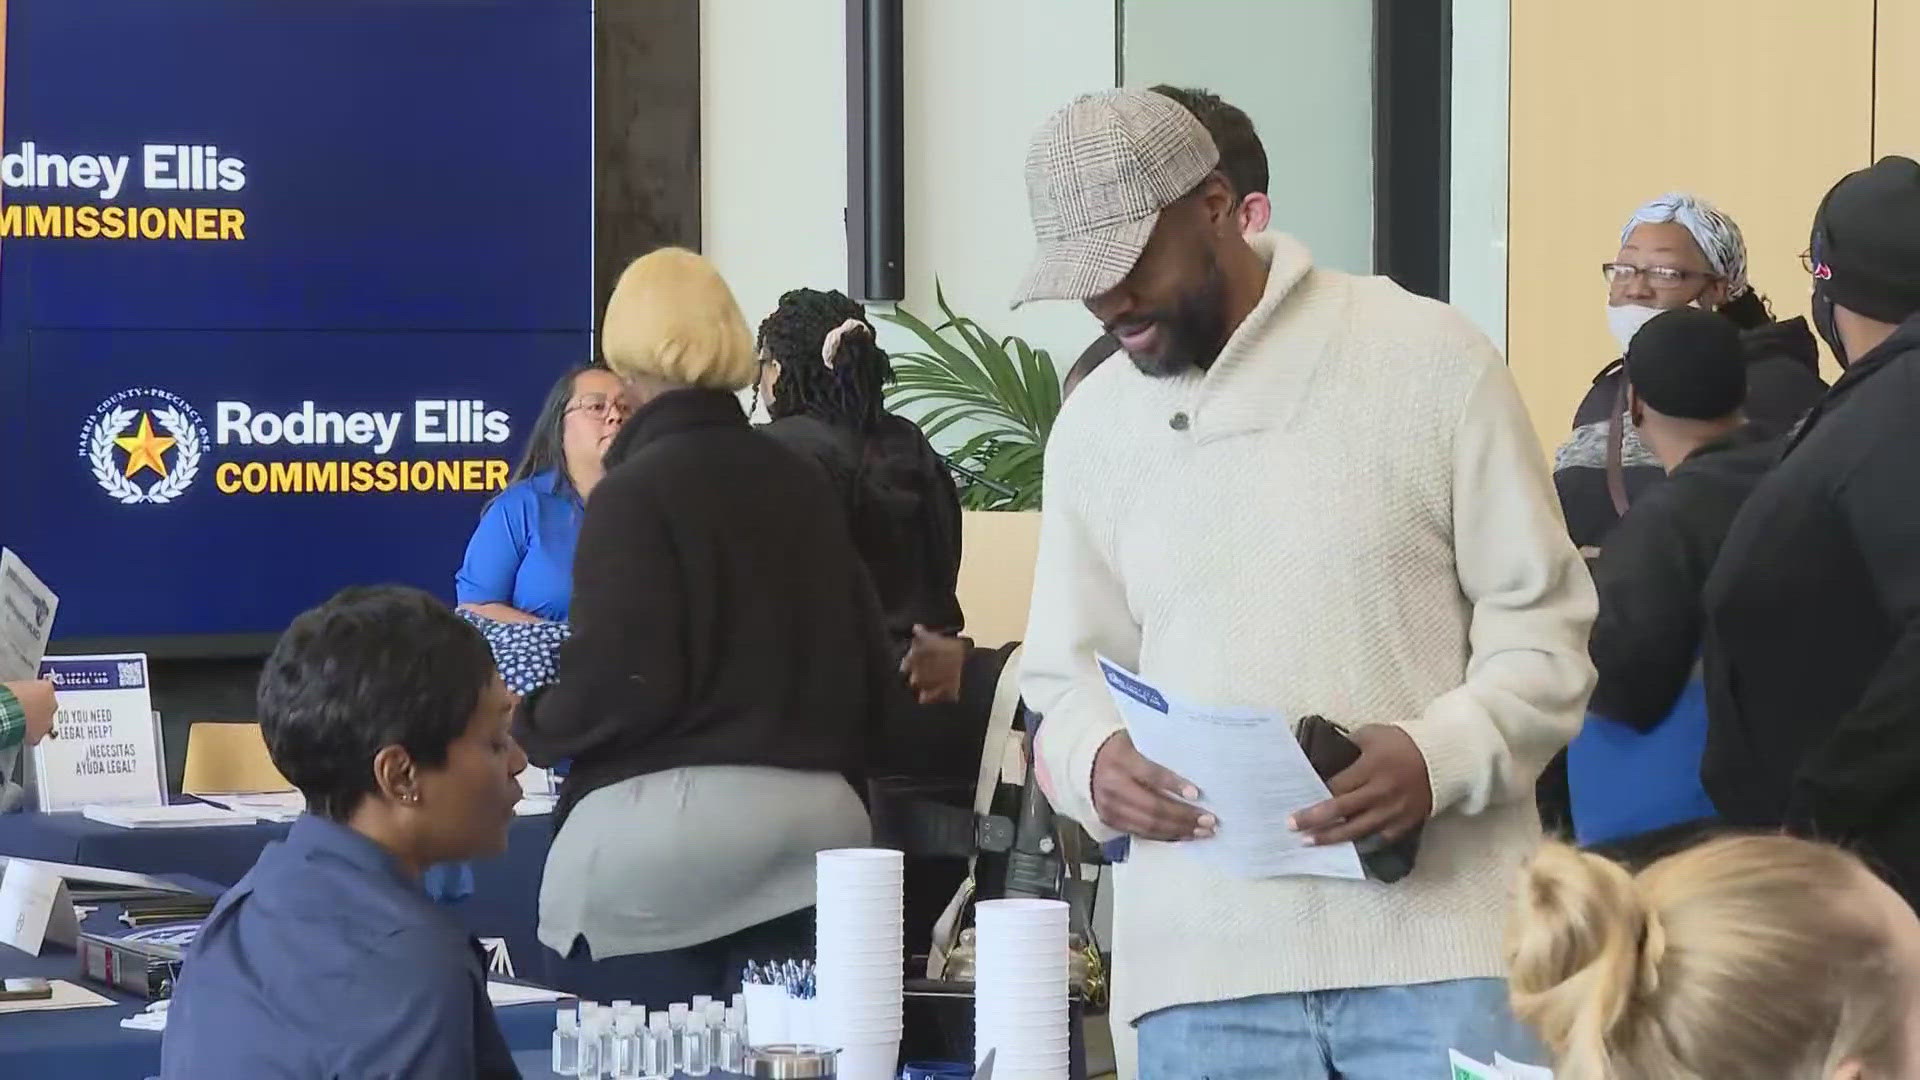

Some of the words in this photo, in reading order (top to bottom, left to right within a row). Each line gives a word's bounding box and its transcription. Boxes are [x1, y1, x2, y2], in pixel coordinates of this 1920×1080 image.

[143, 144, 246, 191] Ellis
[96, 388, 142, 413] COUNTY
[150, 388, 202, 423] PRECINCT
[199, 427, 210, 452] ONE
[216, 400, 402, 454] Rodney
[414, 400, 510, 443] Ellis
[215, 460, 510, 493] COMMISSIONER
[58, 710, 69, 724] DO
[71, 710, 88, 723] YOU
[90, 709, 112, 722] NEED
[59, 726, 85, 740] LEGAL
[87, 725, 113, 739] HELP?
[85, 744, 136, 761] ¿NECESITAS
[76, 760, 105, 776] AYUDA
[106, 759, 137, 774] LEGAL?
